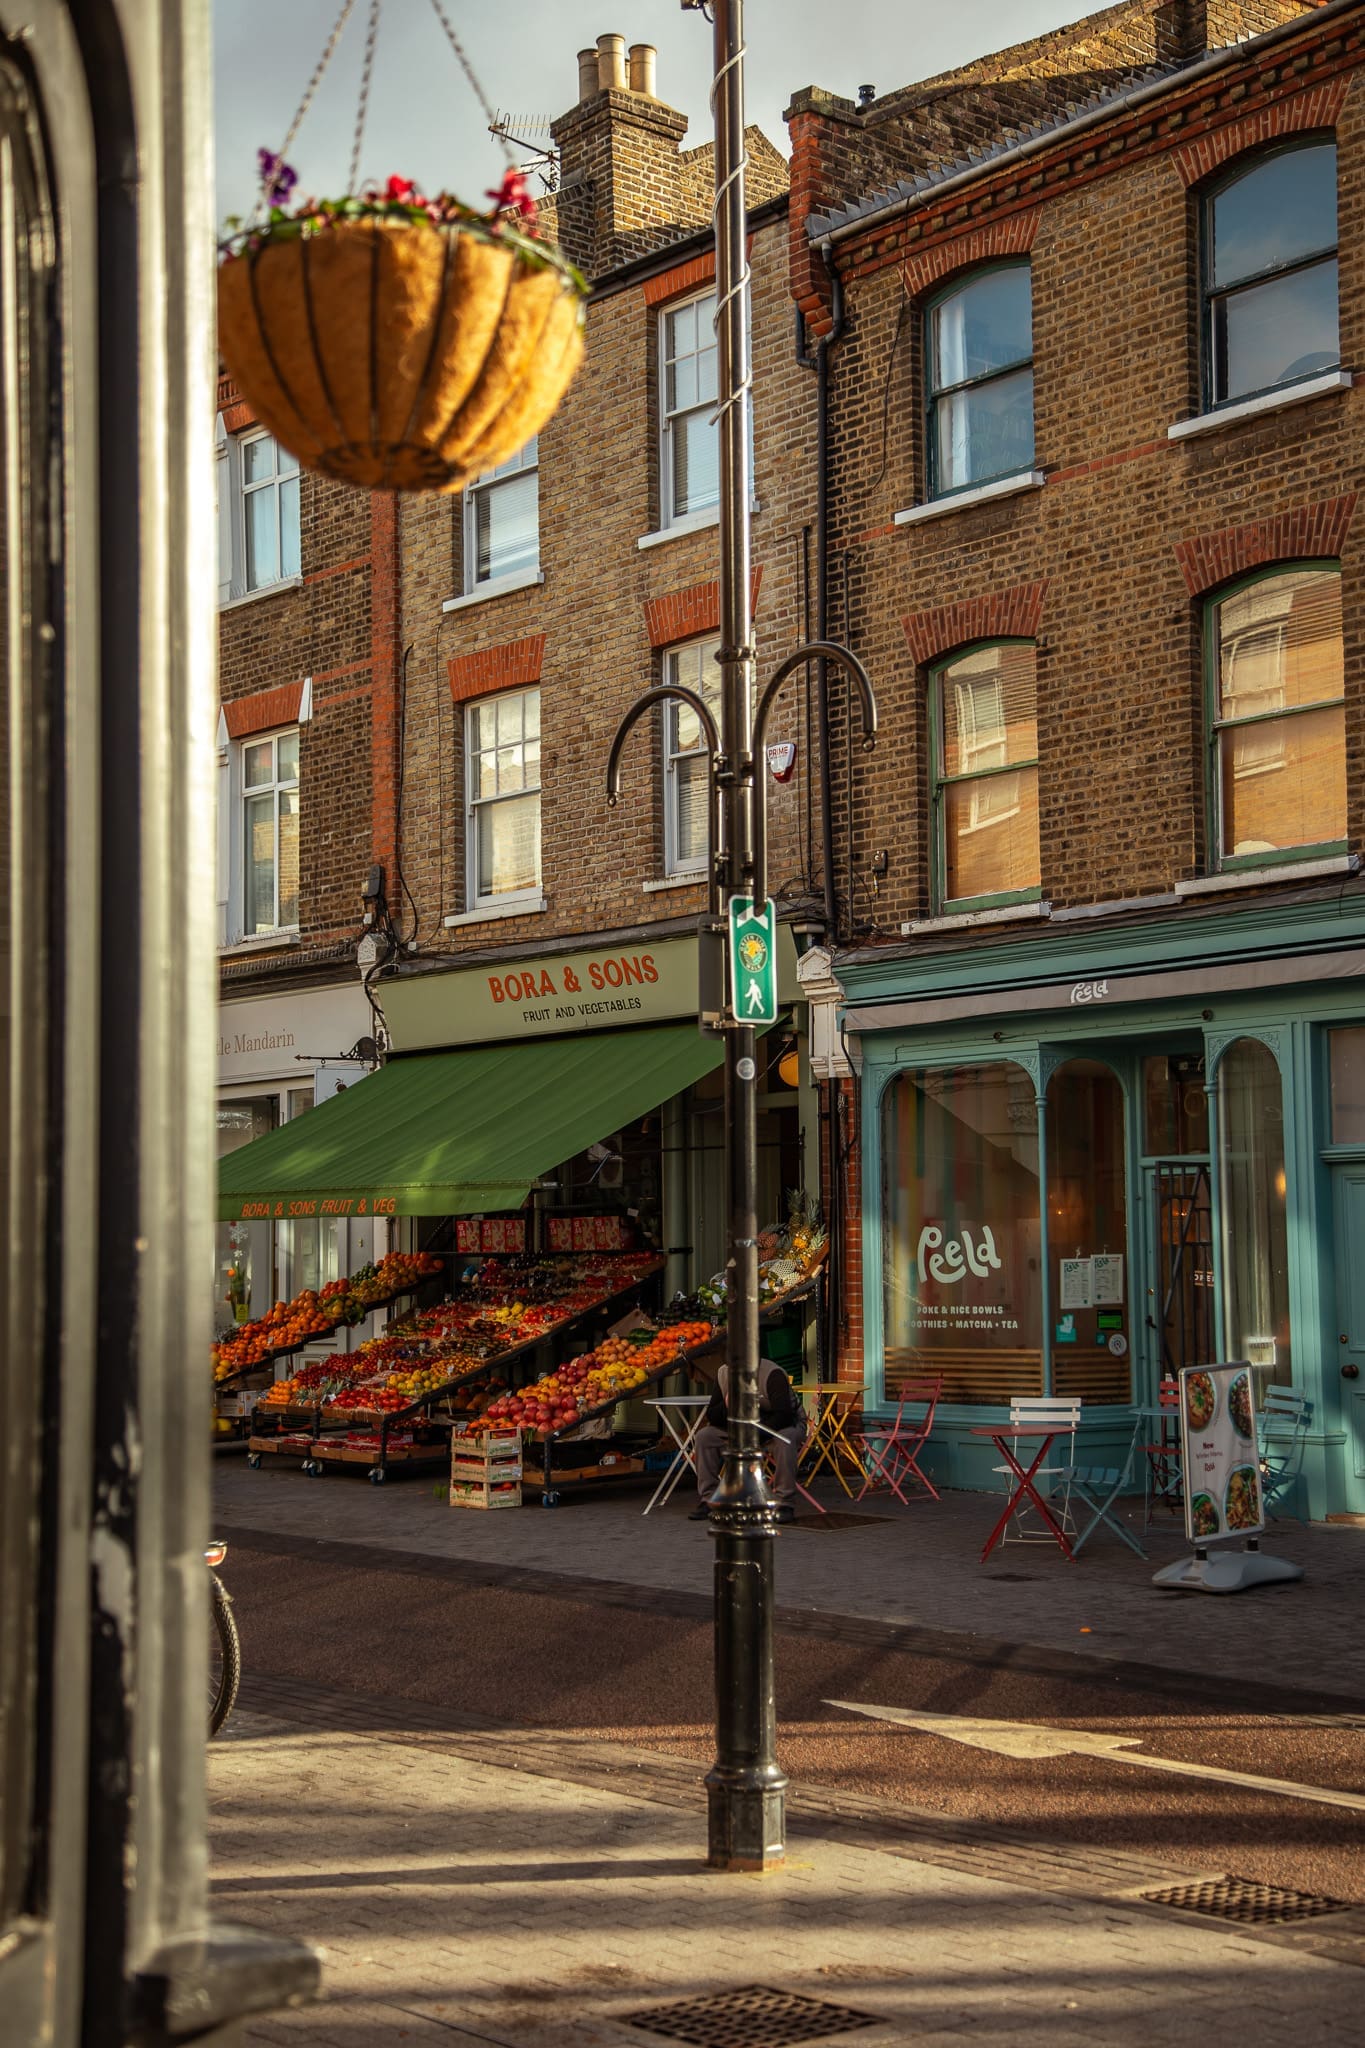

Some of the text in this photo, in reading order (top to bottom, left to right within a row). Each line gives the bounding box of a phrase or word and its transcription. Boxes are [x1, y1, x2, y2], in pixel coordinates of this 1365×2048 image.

[768, 746, 789, 757] PRIME
[488, 955, 659, 1003] BORA & SONS
[523, 997, 642, 1023] FRUIT AND VEGETABLES
[234, 1028, 295, 1054] Mandarin
[241, 1197, 396, 1217] BORA & SONS FRUIT & VEG
[917, 1306, 1004, 1314] POKE & RICE BOWLS
[899, 1320, 1018, 1328] OOTHIES MATCHA TEA
